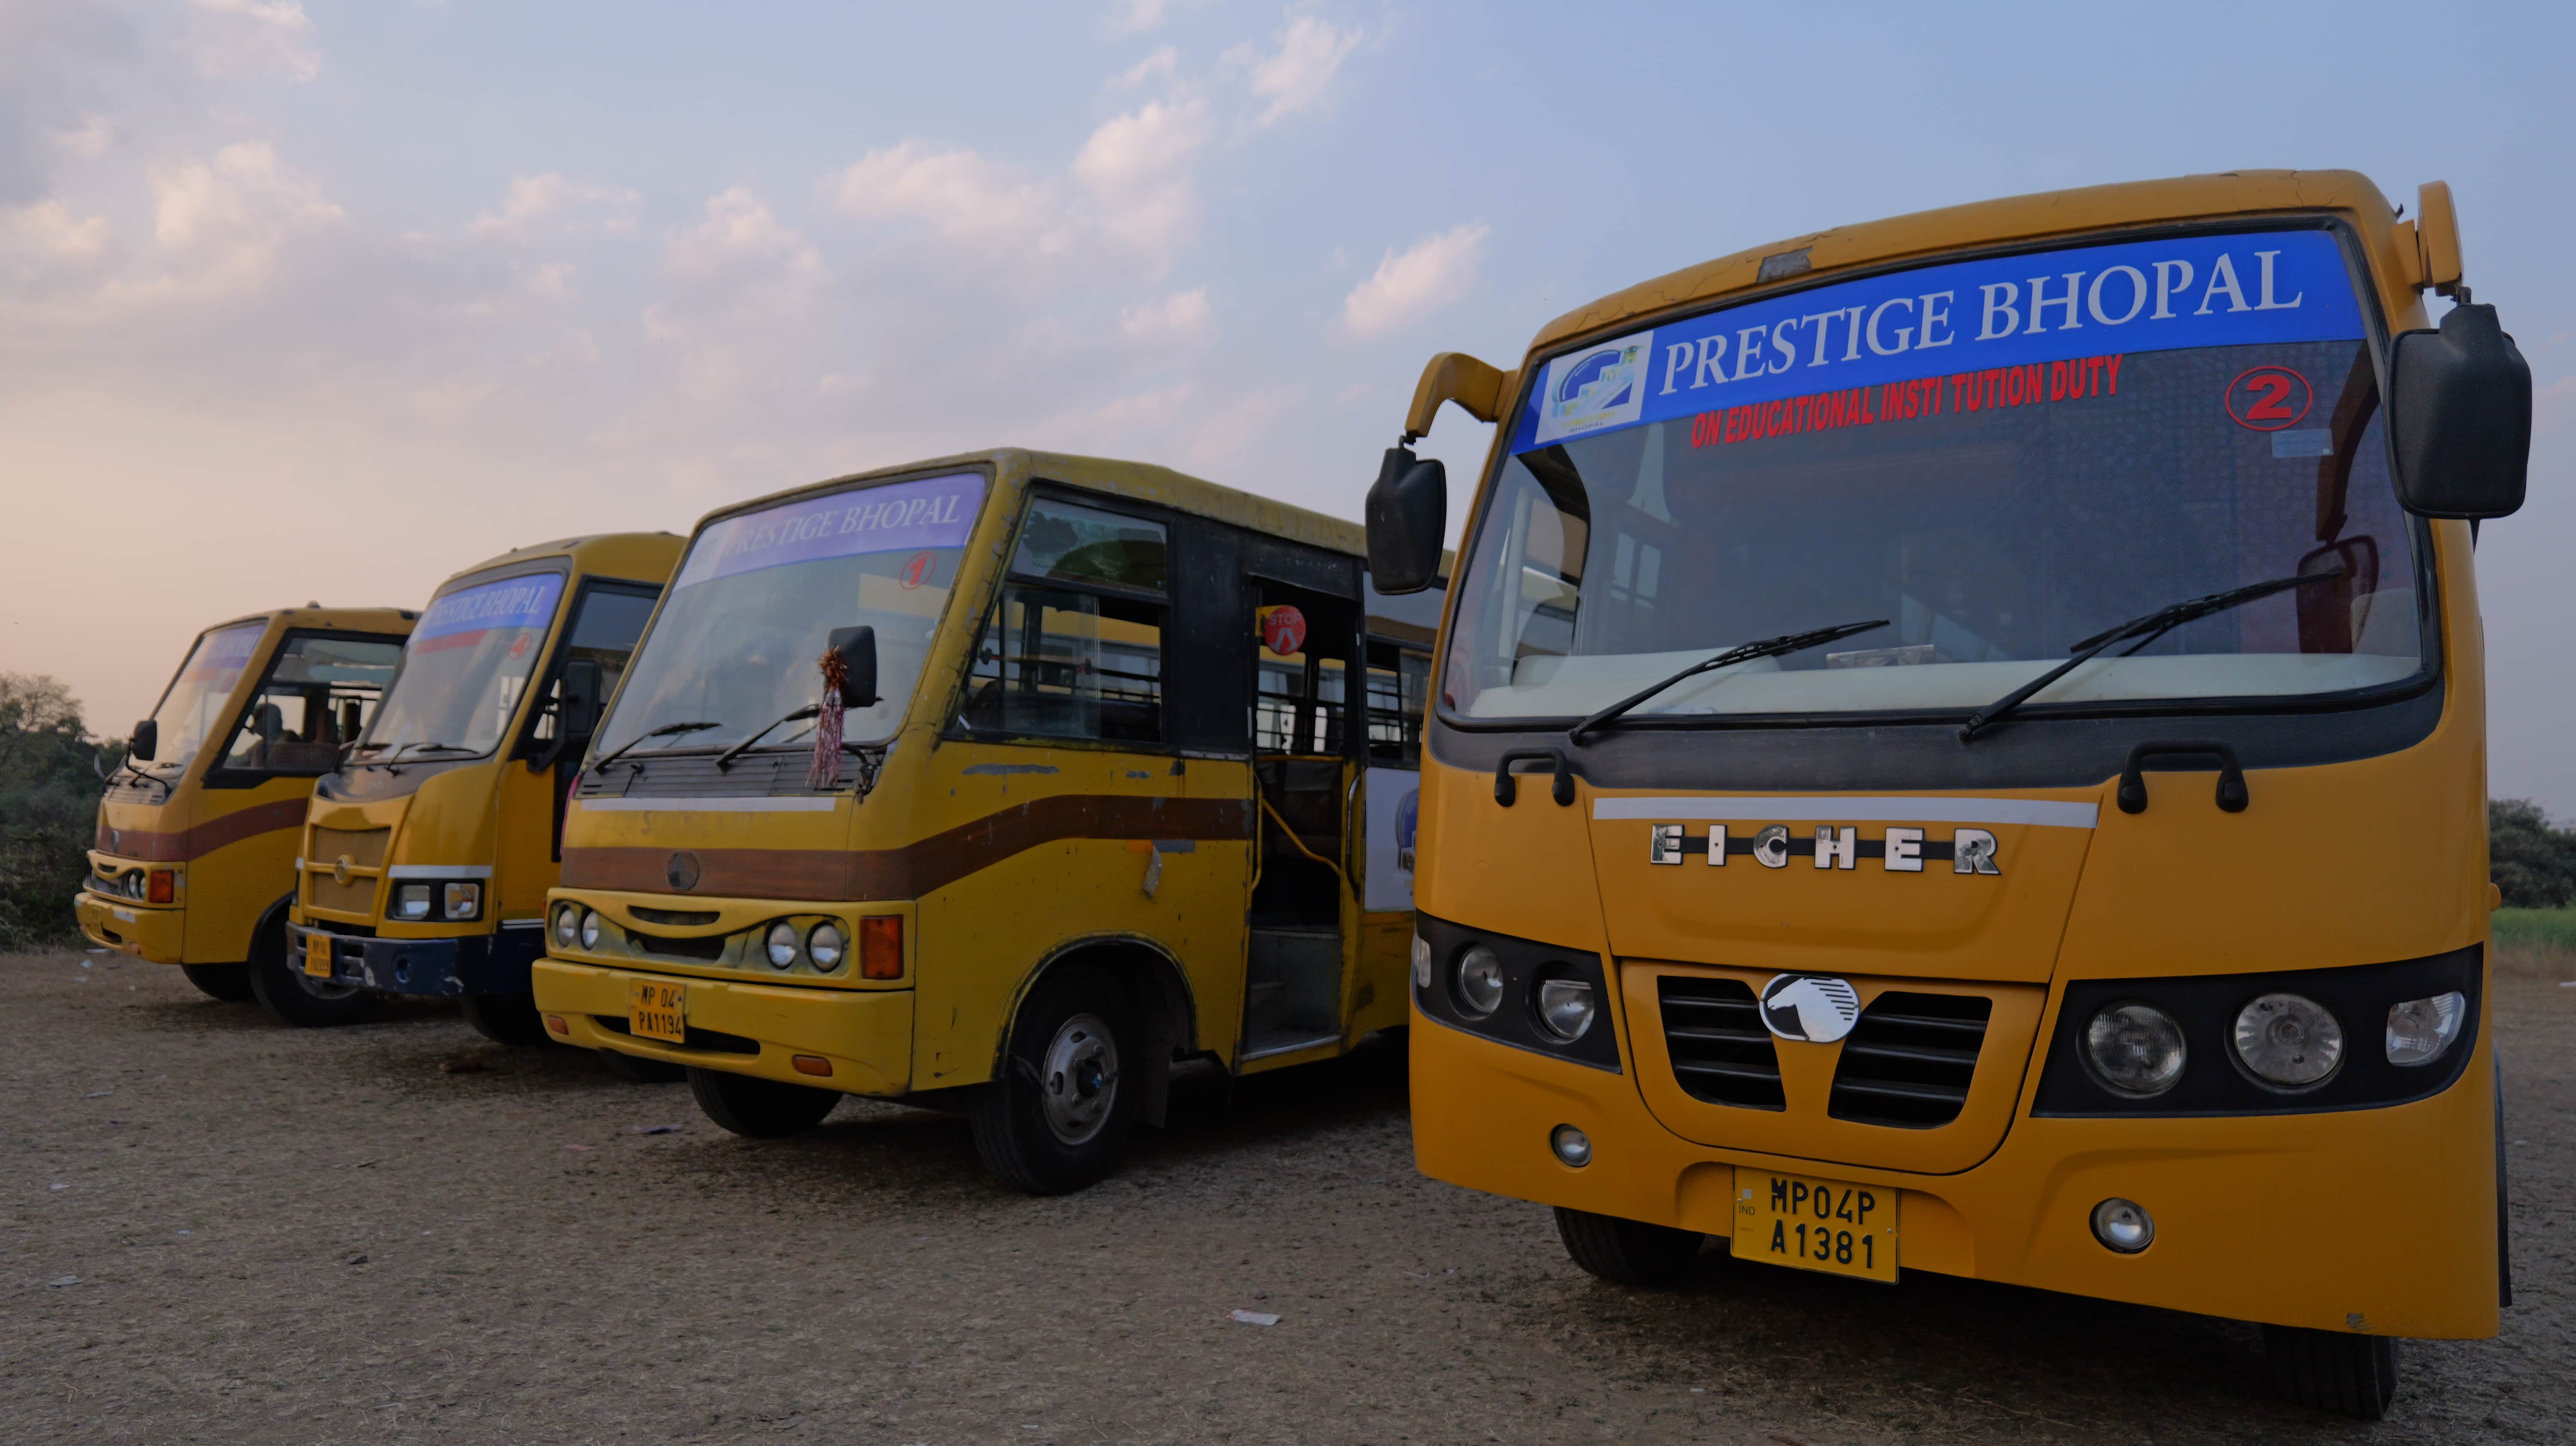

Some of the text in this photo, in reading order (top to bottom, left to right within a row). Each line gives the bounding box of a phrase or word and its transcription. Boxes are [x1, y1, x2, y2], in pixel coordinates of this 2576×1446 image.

[1659, 290, 1954, 395] PRESTIGE
[1975, 250, 2303, 341] BHOPAL
[1692, 354, 2123, 449] ON EDUCATIONAL INSTI TUTION DUTY
[2246, 374, 2292, 420] 2
[1569, 421, 1604, 433] BHOPAL
[726, 495, 961, 556] PRESTIGE BHOPAL
[908, 556, 927, 586] 1
[478, 585, 547, 617] BHOPAL
[1269, 613, 1300, 626] STOP
[1650, 823, 2002, 875] EICHER
[641, 985, 676, 1009] MP 04
[639, 1010, 681, 1035] PA1194
[1739, 1205, 1755, 1215] IND
[1771, 1178, 1875, 1225] MP04P
[1770, 1219, 1872, 1269] A1381
